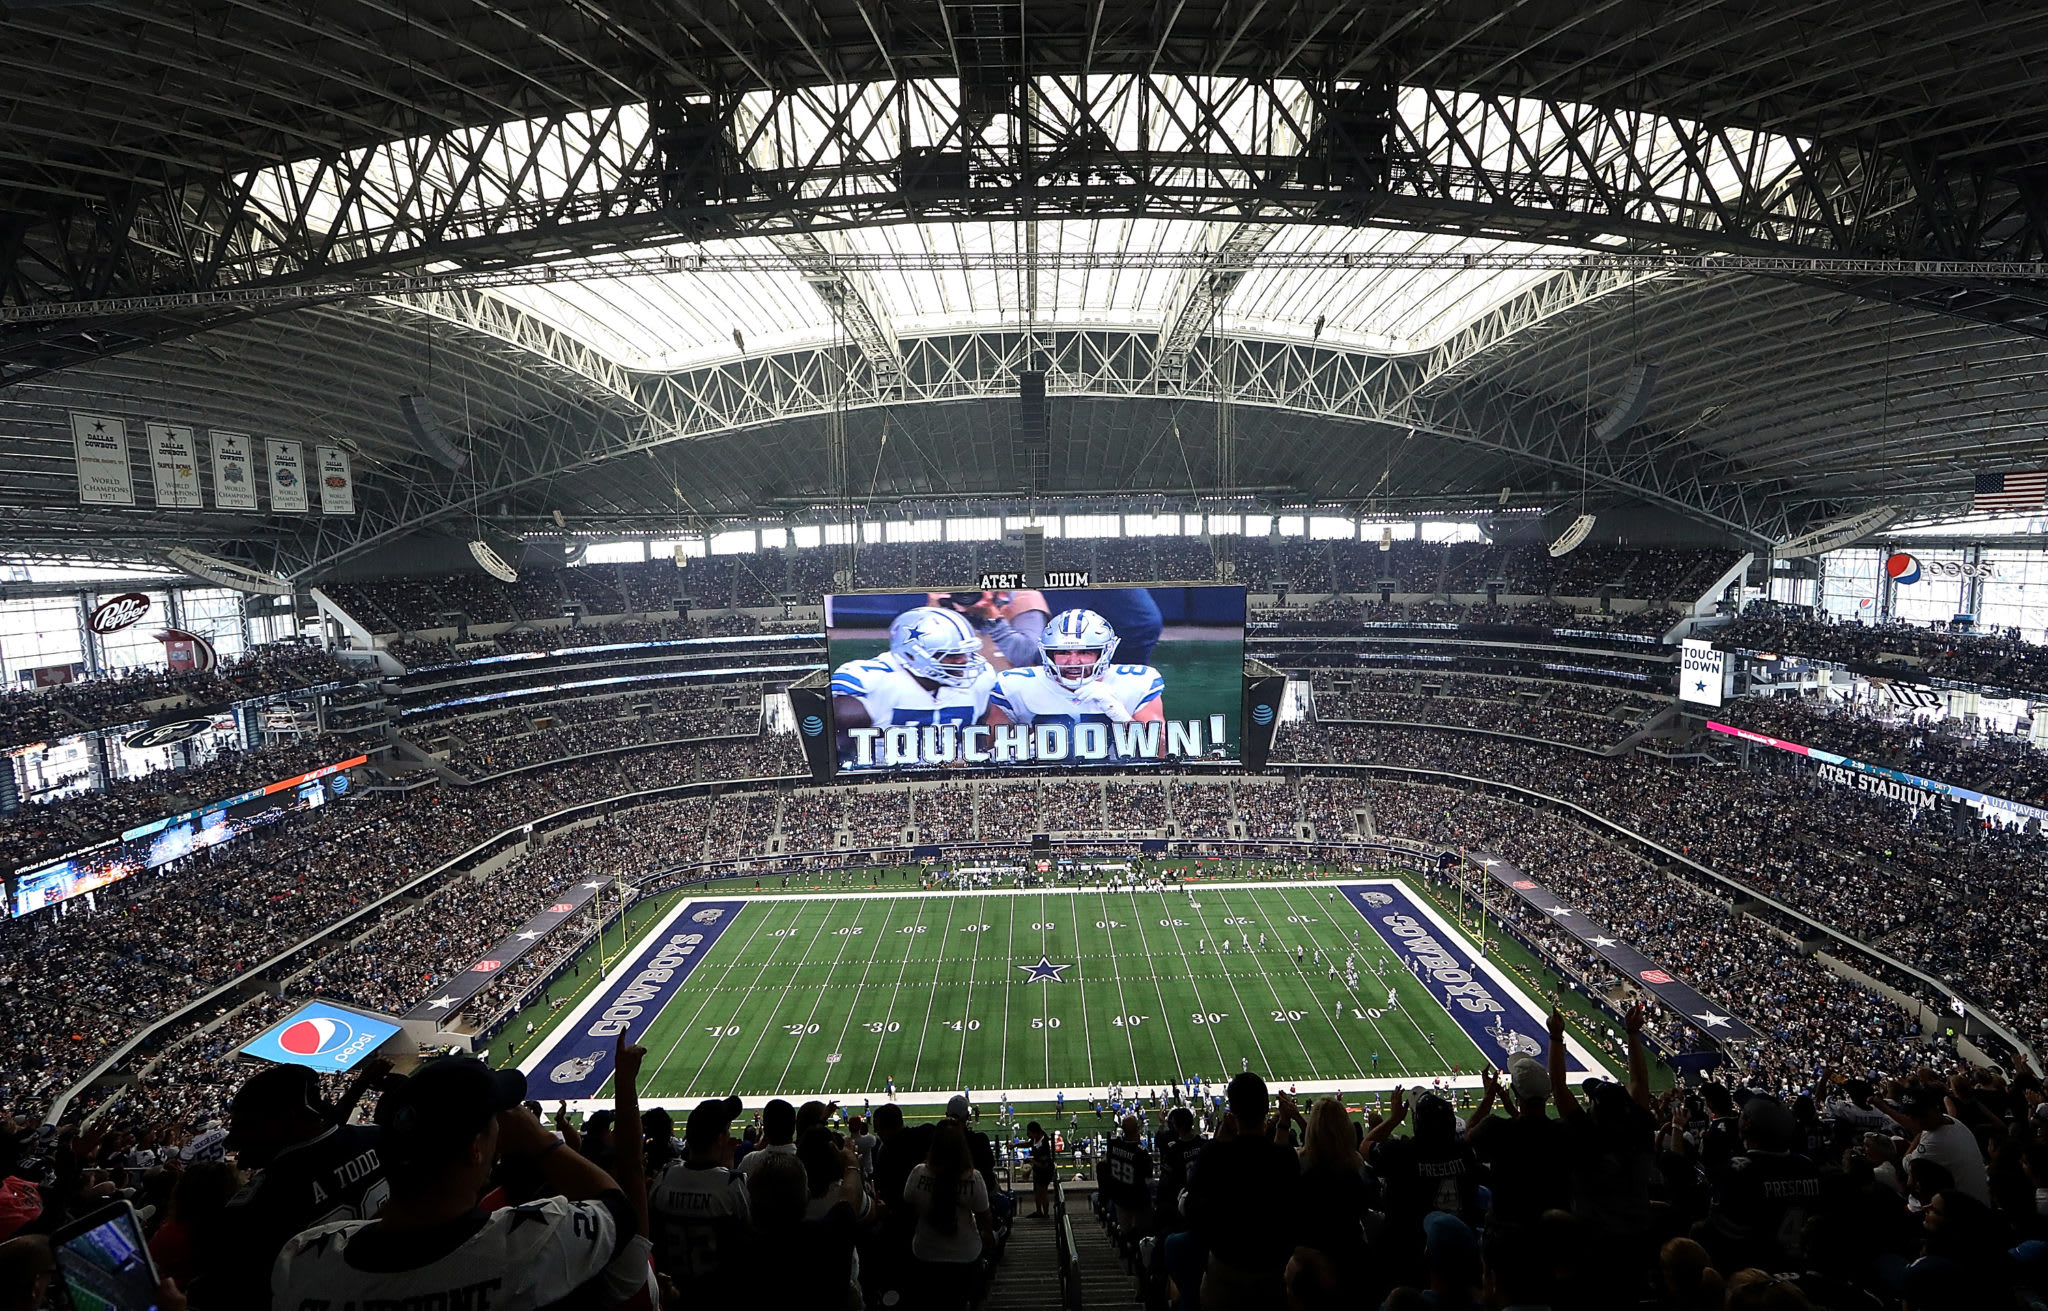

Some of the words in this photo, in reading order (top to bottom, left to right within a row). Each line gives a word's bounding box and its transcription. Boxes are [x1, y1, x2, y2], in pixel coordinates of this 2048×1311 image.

[87, 434, 114, 442] DALLAS
[85, 441, 118, 450] COWBOYS
[220, 454, 244, 462] COWBOYS
[981, 573, 1018, 590] AT&T
[1021, 572, 1089, 589] SDIUM
[119, 599, 139, 615] Dr
[94, 603, 148, 630] Pepper
[1684, 648, 1722, 662] TOUCH
[1684, 660, 1720, 674] DOWN
[847, 713, 1227, 766] TOUCHDOWN!
[1817, 763, 1855, 786] AT&T
[1858, 775, 1937, 811] STADIUM
[1992, 799, 2008, 811] UTA
[1383, 915, 1505, 1012] COWBOYS
[588, 934, 703, 1036] COWBOYS
[1112, 1015, 1140, 1026] 40
[1191, 1013, 1221, 1024] 30
[1271, 1010, 1301, 1021] 20
[1351, 1008, 1381, 1019] 10
[789, 1023, 819, 1035] 20
[870, 1022, 900, 1033] 30
[951, 1020, 980, 1031] 40
[1032, 1017, 1060, 1029] 50
[710, 1025, 740, 1036] 10
[334, 1032, 377, 1063] pepsi
[333, 1148, 381, 1189] TODD
[1110, 1158, 1136, 1185] 29
[1417, 1157, 1466, 1177] PRESCOTT
[1762, 1177, 1821, 1199] PRESCOTT
